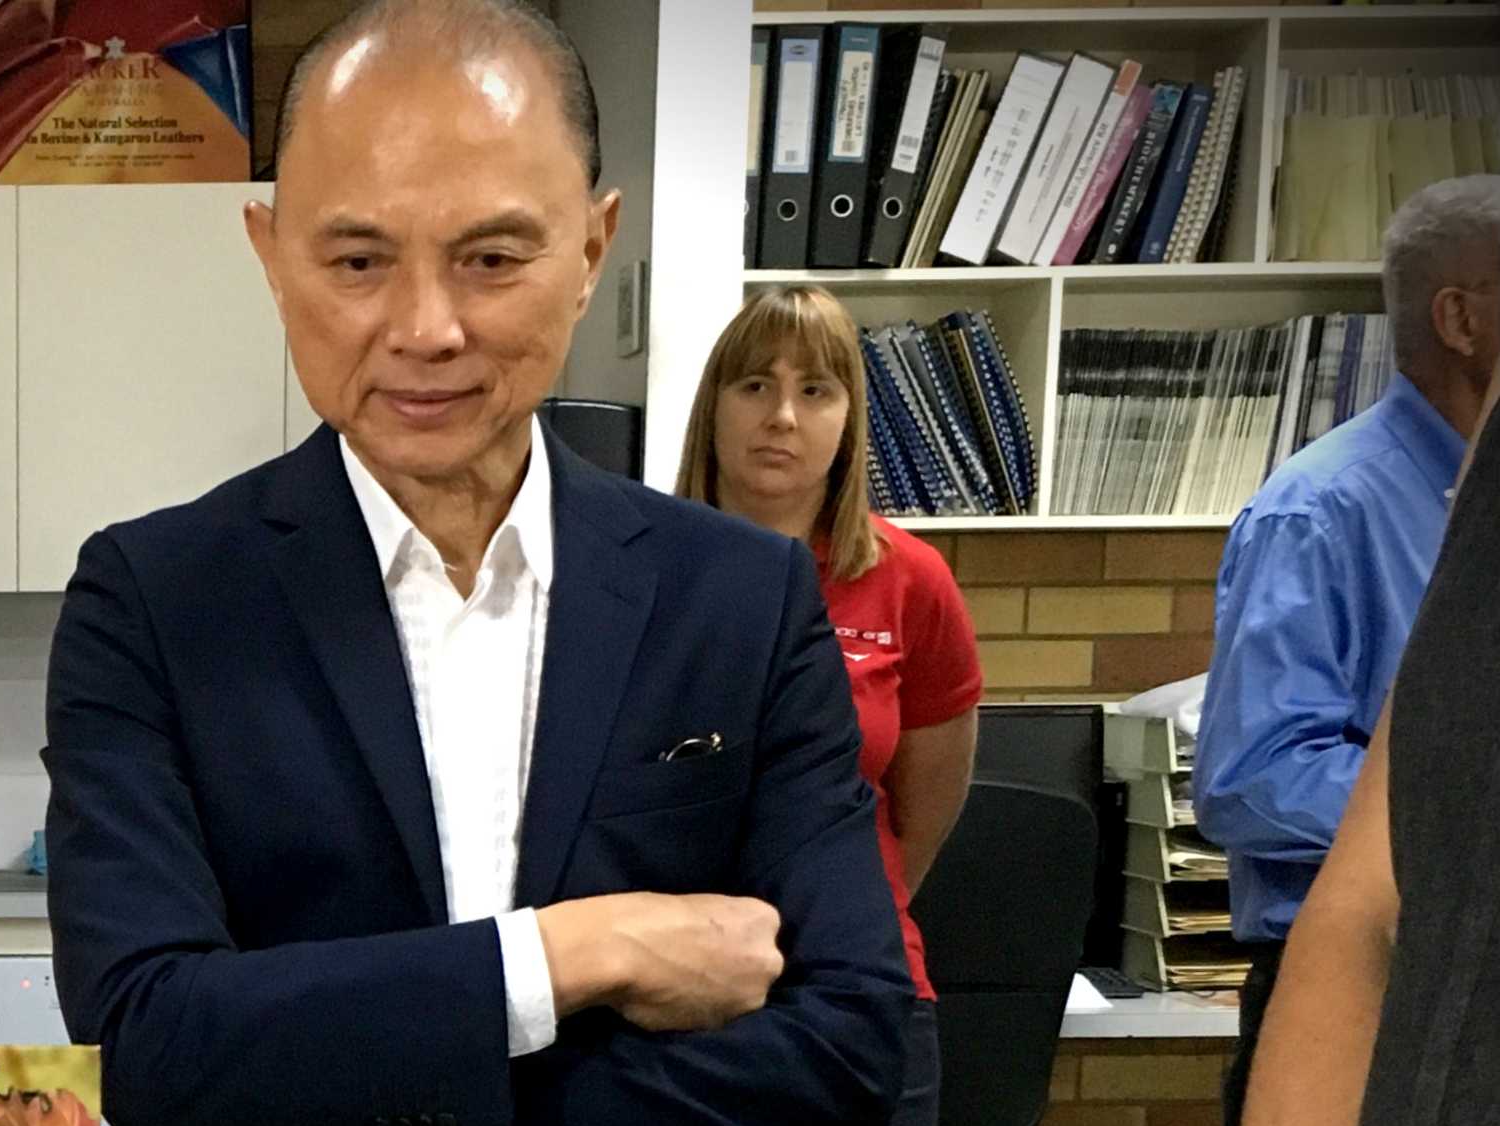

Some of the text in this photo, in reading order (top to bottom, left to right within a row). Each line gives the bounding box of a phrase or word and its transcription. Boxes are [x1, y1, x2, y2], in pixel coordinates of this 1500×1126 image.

[52, 116, 178, 129] The Natural Selection
[41, 132, 82, 144] Bovine
[83, 132, 91, 144] &
[94, 132, 151, 145] Kangaroo
[153, 131, 205, 144] Leathers
[1113, 131, 1156, 234] BIOCHEMISTRY
